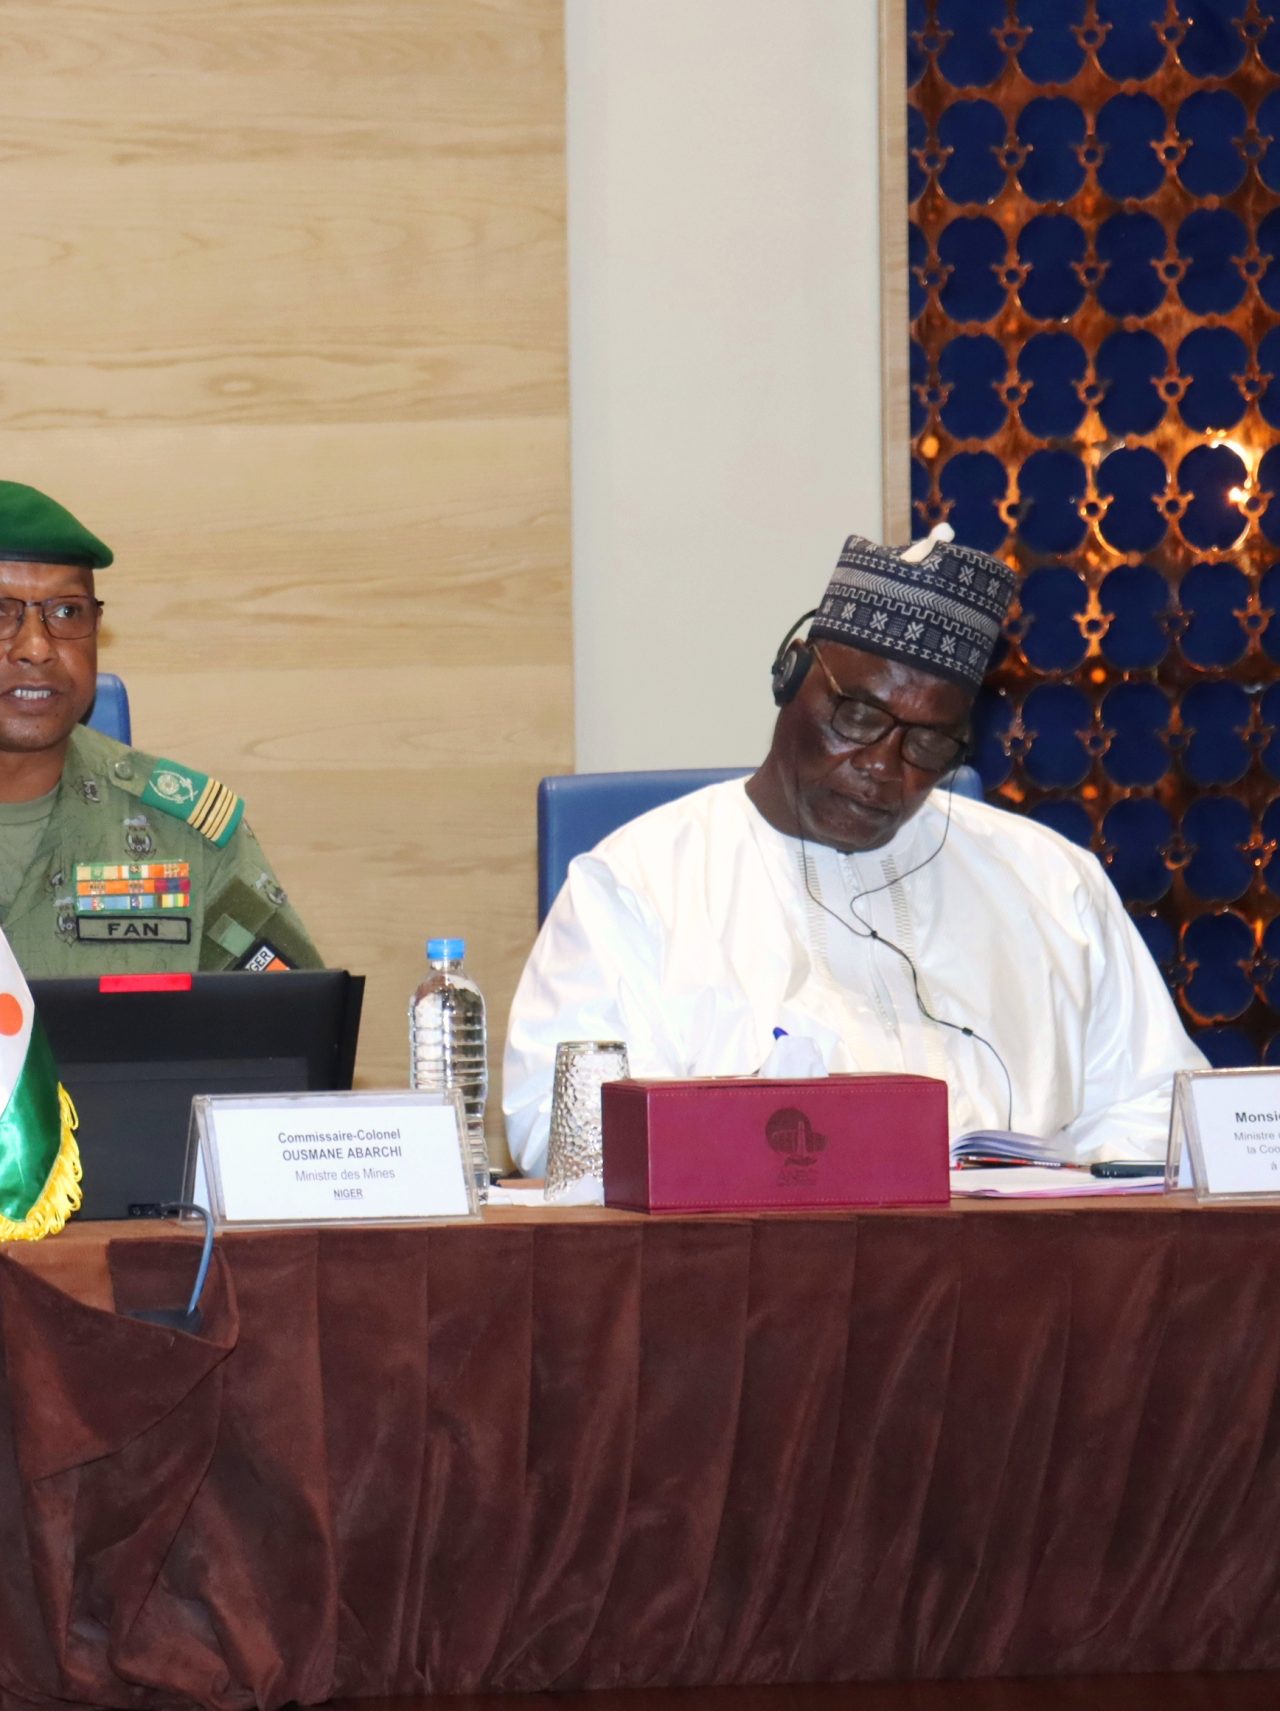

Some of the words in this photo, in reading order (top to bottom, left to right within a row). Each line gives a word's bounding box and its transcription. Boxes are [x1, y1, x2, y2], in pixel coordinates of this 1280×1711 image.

[107, 922, 159, 937] FAN
[1235, 1111, 1280, 1123] Monsi
[277, 1128, 401, 1144] Commissaire-Colonel
[1234, 1131, 1275, 1141] Ministre
[282, 1147, 344, 1162] OUSMANE
[347, 1145, 402, 1159] ABARCHI
[1246, 1146, 1257, 1155] la
[295, 1169, 338, 1182] Ministre
[341, 1168, 360, 1180] des
[363, 1166, 395, 1179] Mines
[333, 1188, 363, 1199] NIGER
